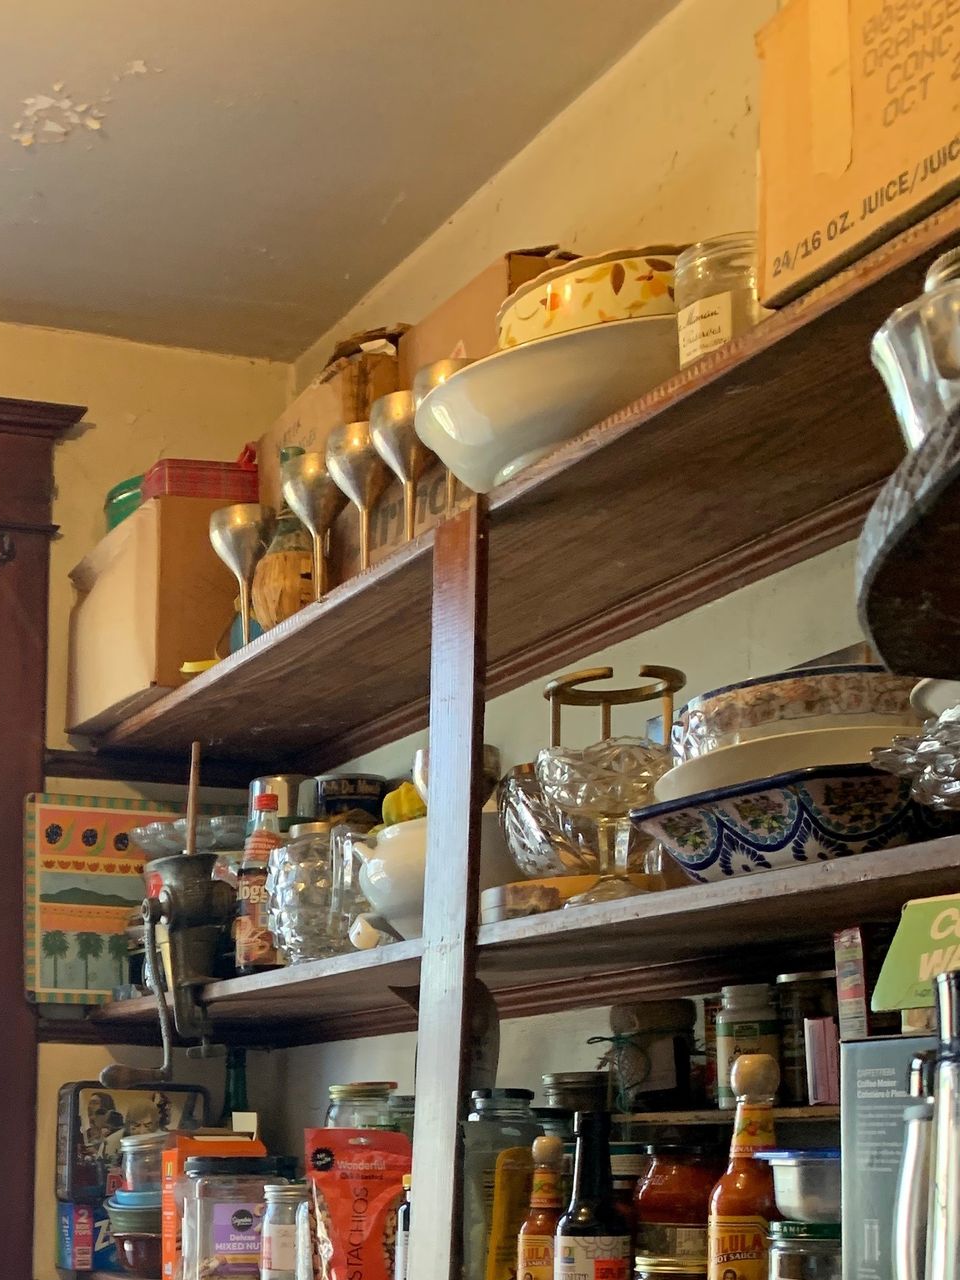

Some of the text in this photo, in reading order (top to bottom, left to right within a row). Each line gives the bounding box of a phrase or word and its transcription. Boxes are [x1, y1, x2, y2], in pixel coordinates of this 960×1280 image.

[883, 72, 935, 128] OCT
[773, 230, 821, 277] 24/16
[827, 210, 855, 241] OZ.
[857, 1079, 896, 1088] Coffee Maker
[337, 1160, 385, 1170] Wonderful
[215, 1242, 244, 1250] MIXED
[730, 1252, 761, 1261] SAUCE
